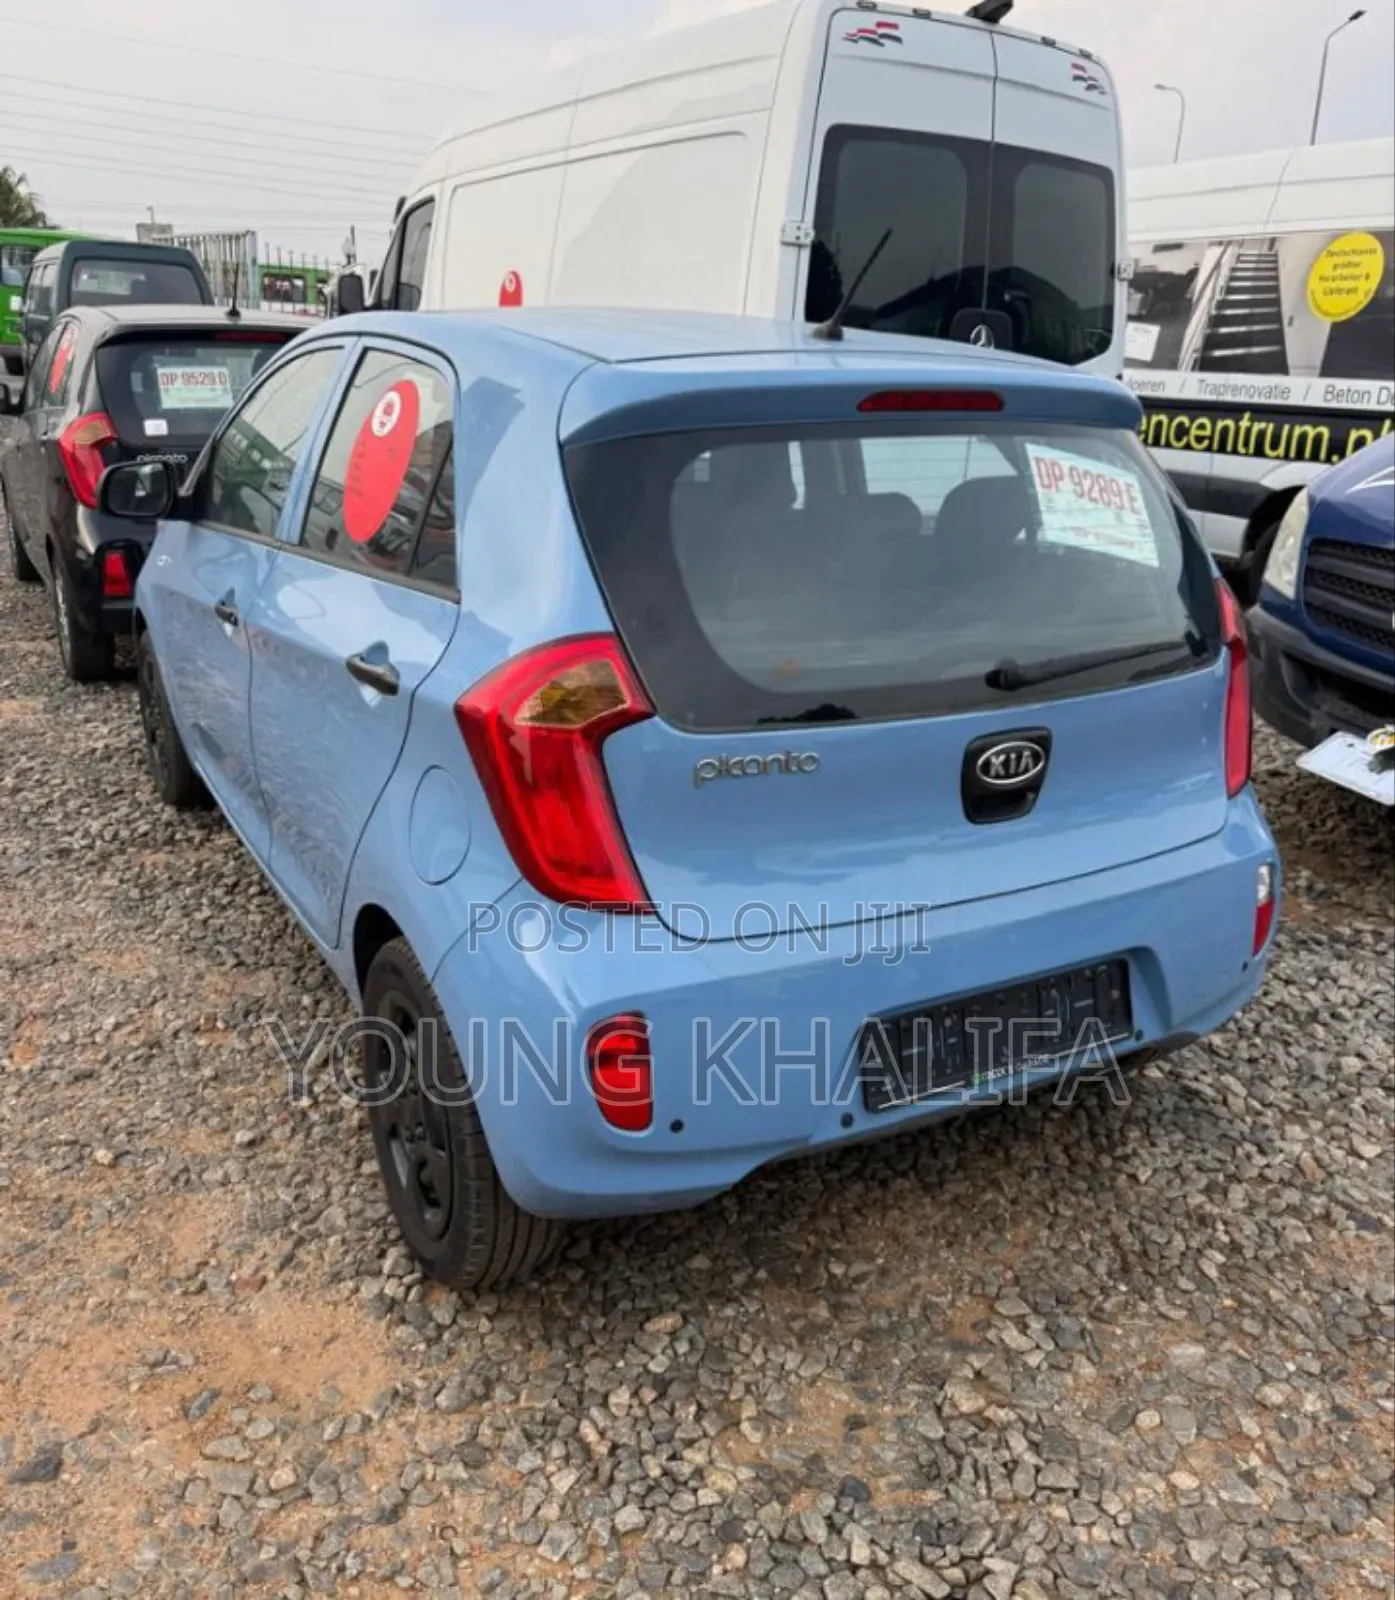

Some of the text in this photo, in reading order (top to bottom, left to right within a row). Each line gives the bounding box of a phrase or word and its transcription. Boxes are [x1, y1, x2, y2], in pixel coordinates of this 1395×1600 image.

[1197, 379, 1291, 401] Traprenovatie
[1323, 383, 1372, 404] Beton
[1034, 456, 1065, 493] DP
[693, 749, 822, 790] picanto
[987, 749, 1037, 778] KIA
